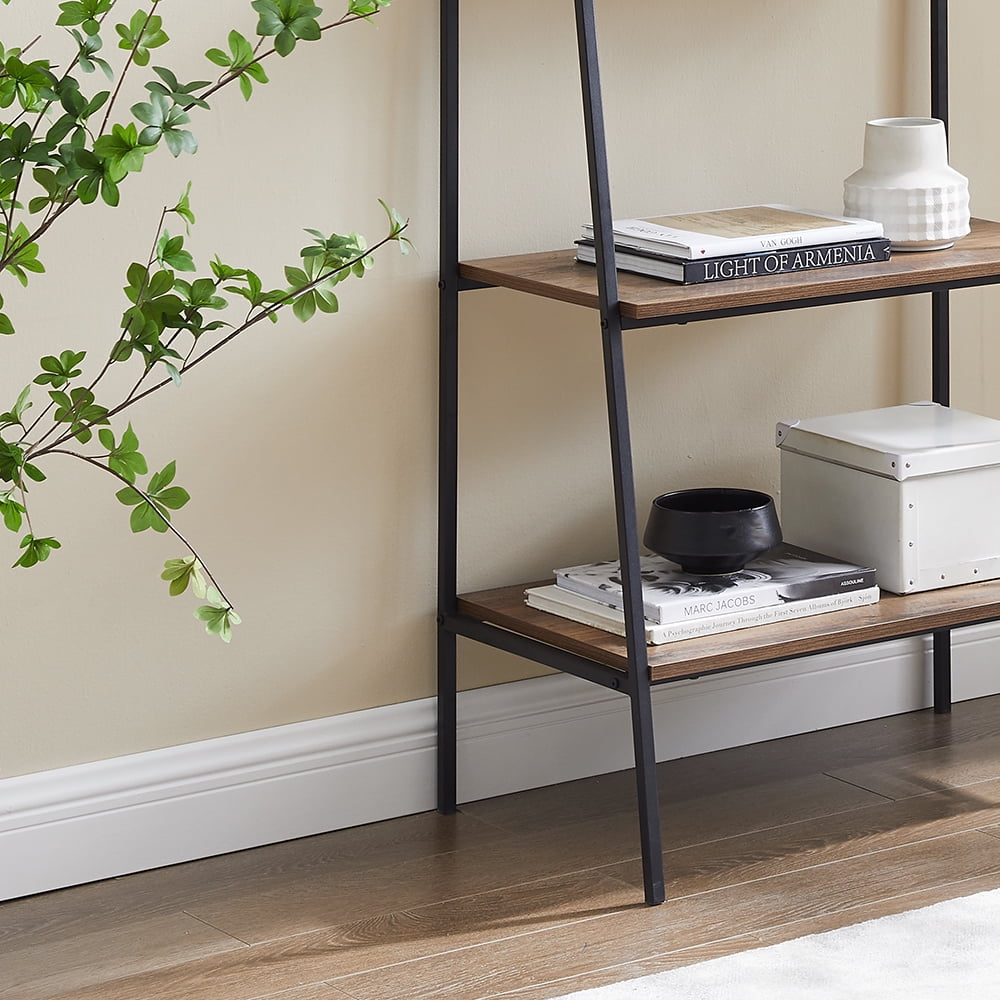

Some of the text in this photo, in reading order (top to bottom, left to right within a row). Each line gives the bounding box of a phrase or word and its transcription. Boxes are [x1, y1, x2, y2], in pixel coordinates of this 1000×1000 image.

[760, 236, 803, 248] VAN GOGH
[703, 243, 876, 280] LIGHT OF ARMENIA
[683, 594, 756, 617] MARC JACOBS
